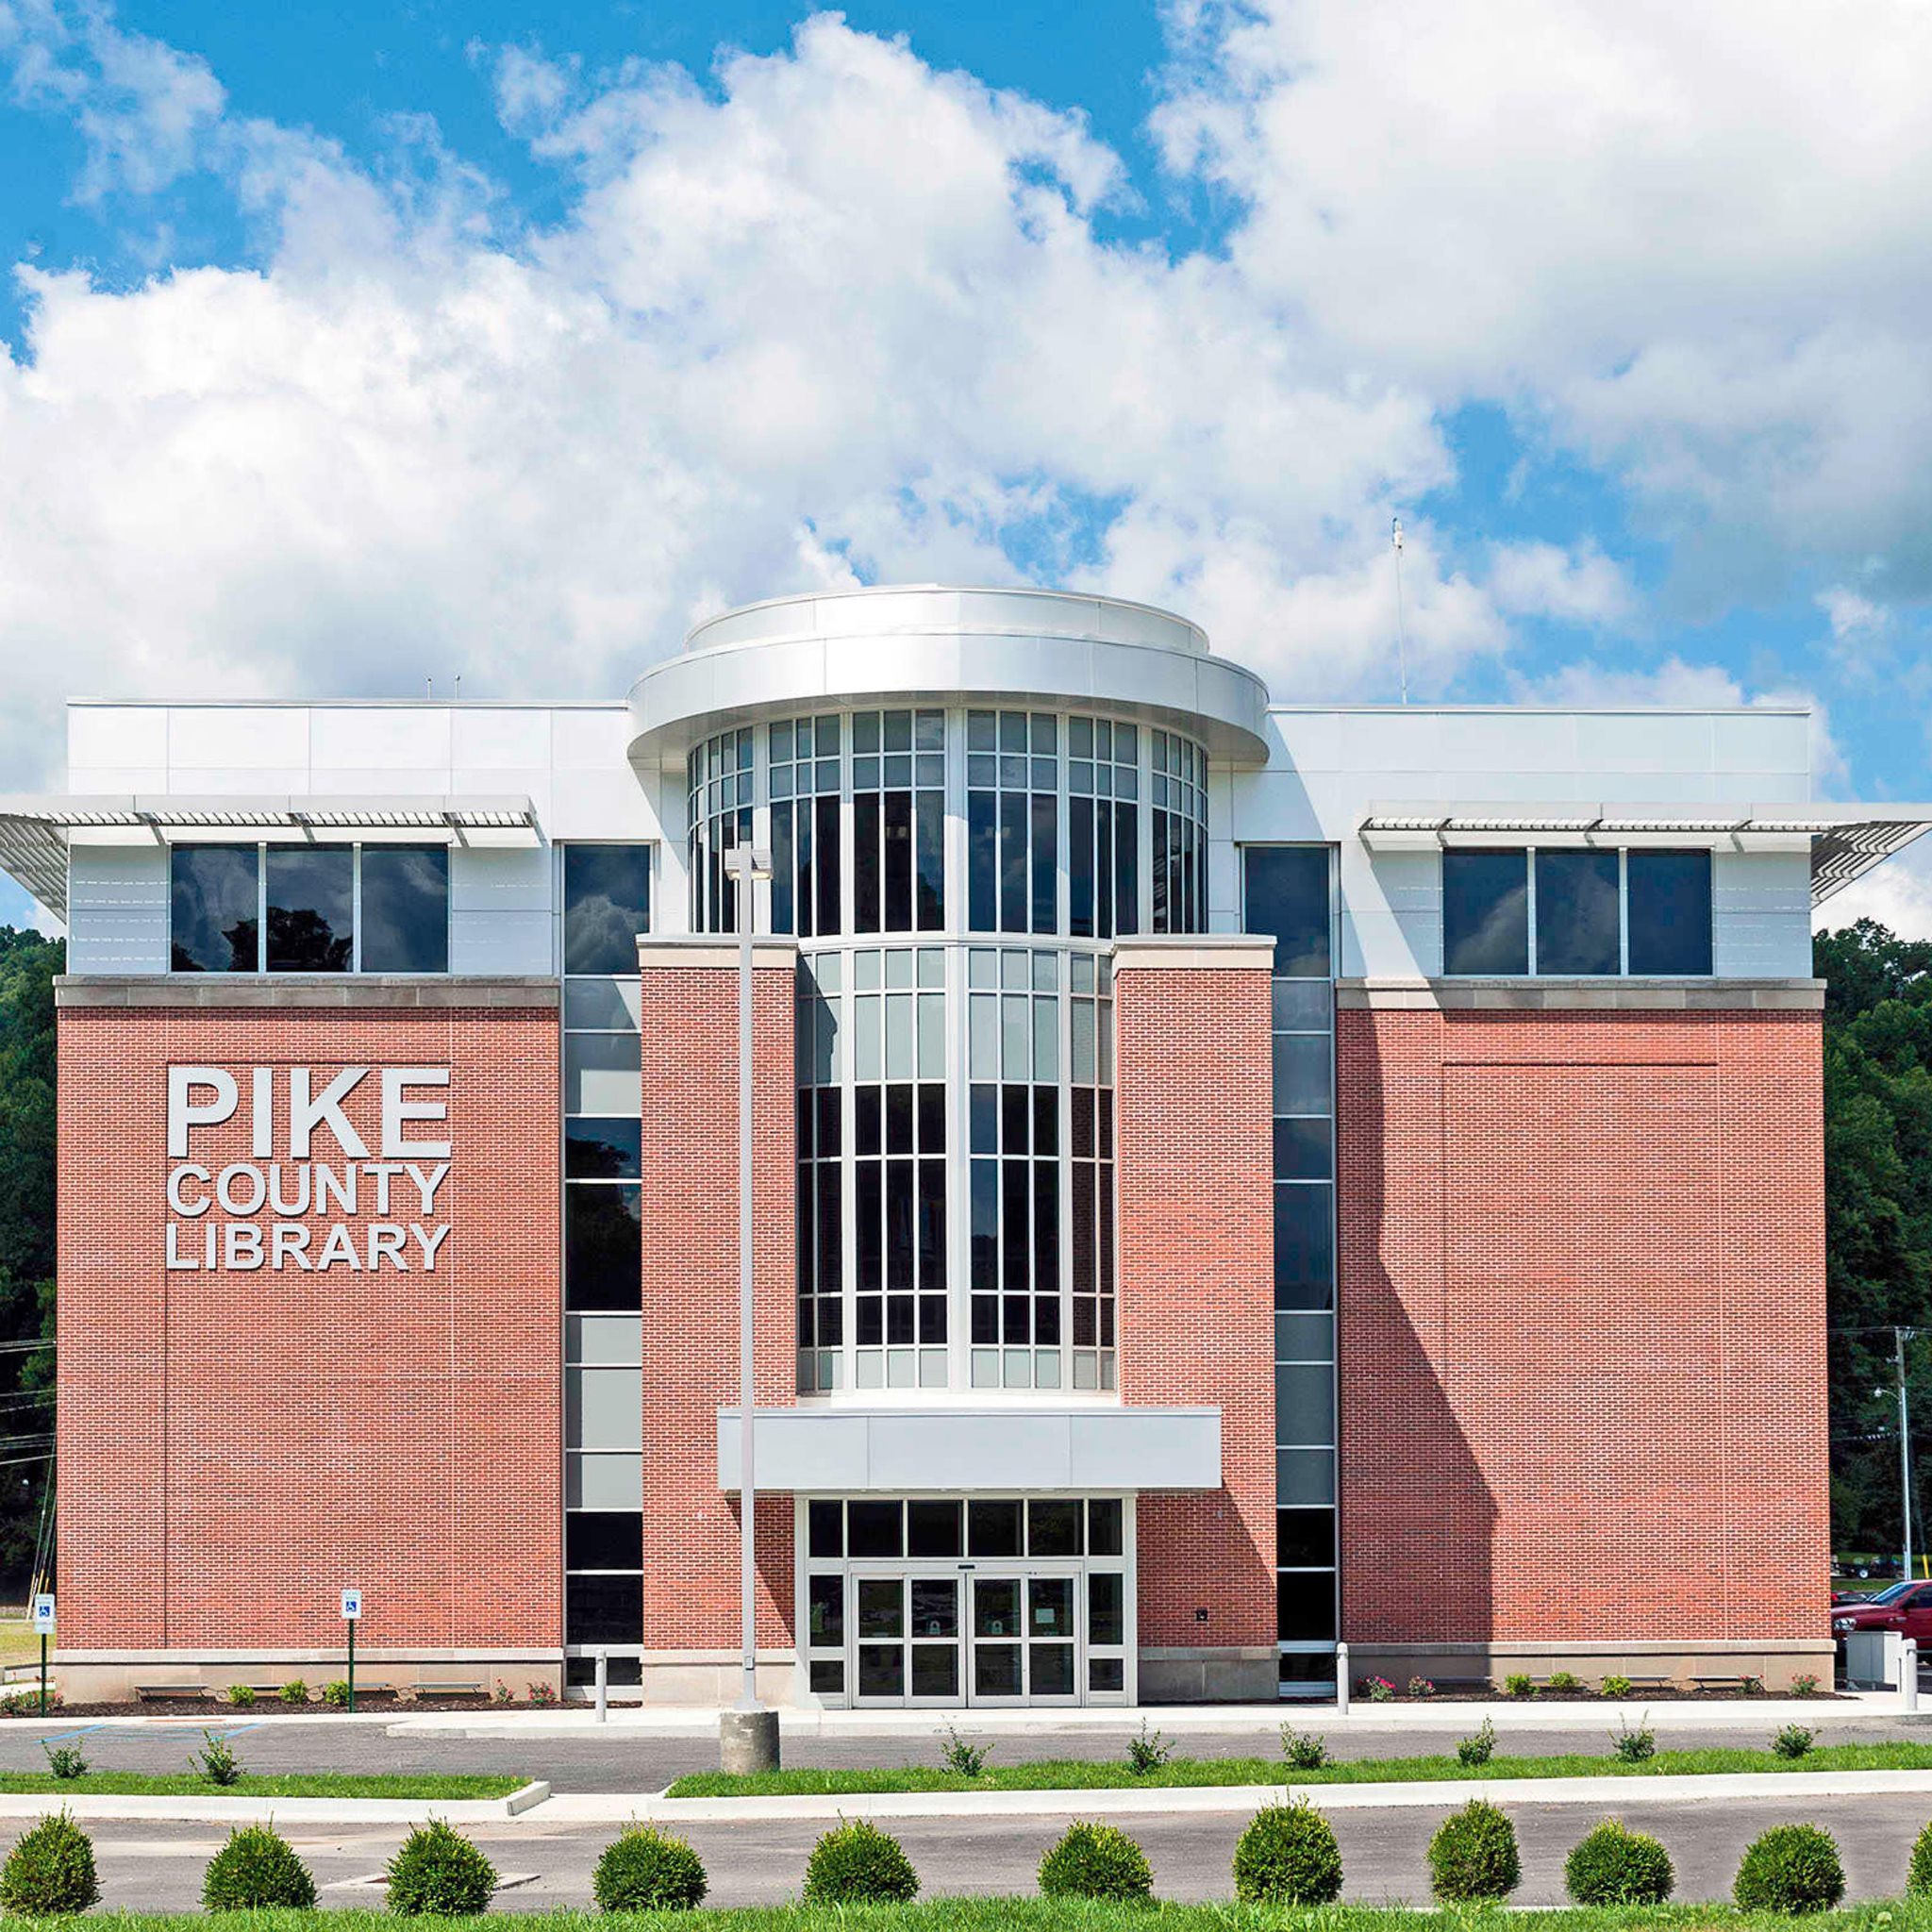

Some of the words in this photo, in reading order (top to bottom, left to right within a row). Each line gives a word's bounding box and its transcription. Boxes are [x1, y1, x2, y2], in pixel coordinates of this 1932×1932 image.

[168, 1067, 451, 1158] PIKE
[167, 1163, 451, 1216] COUNTY
[166, 1223, 451, 1270] LIBRARY
